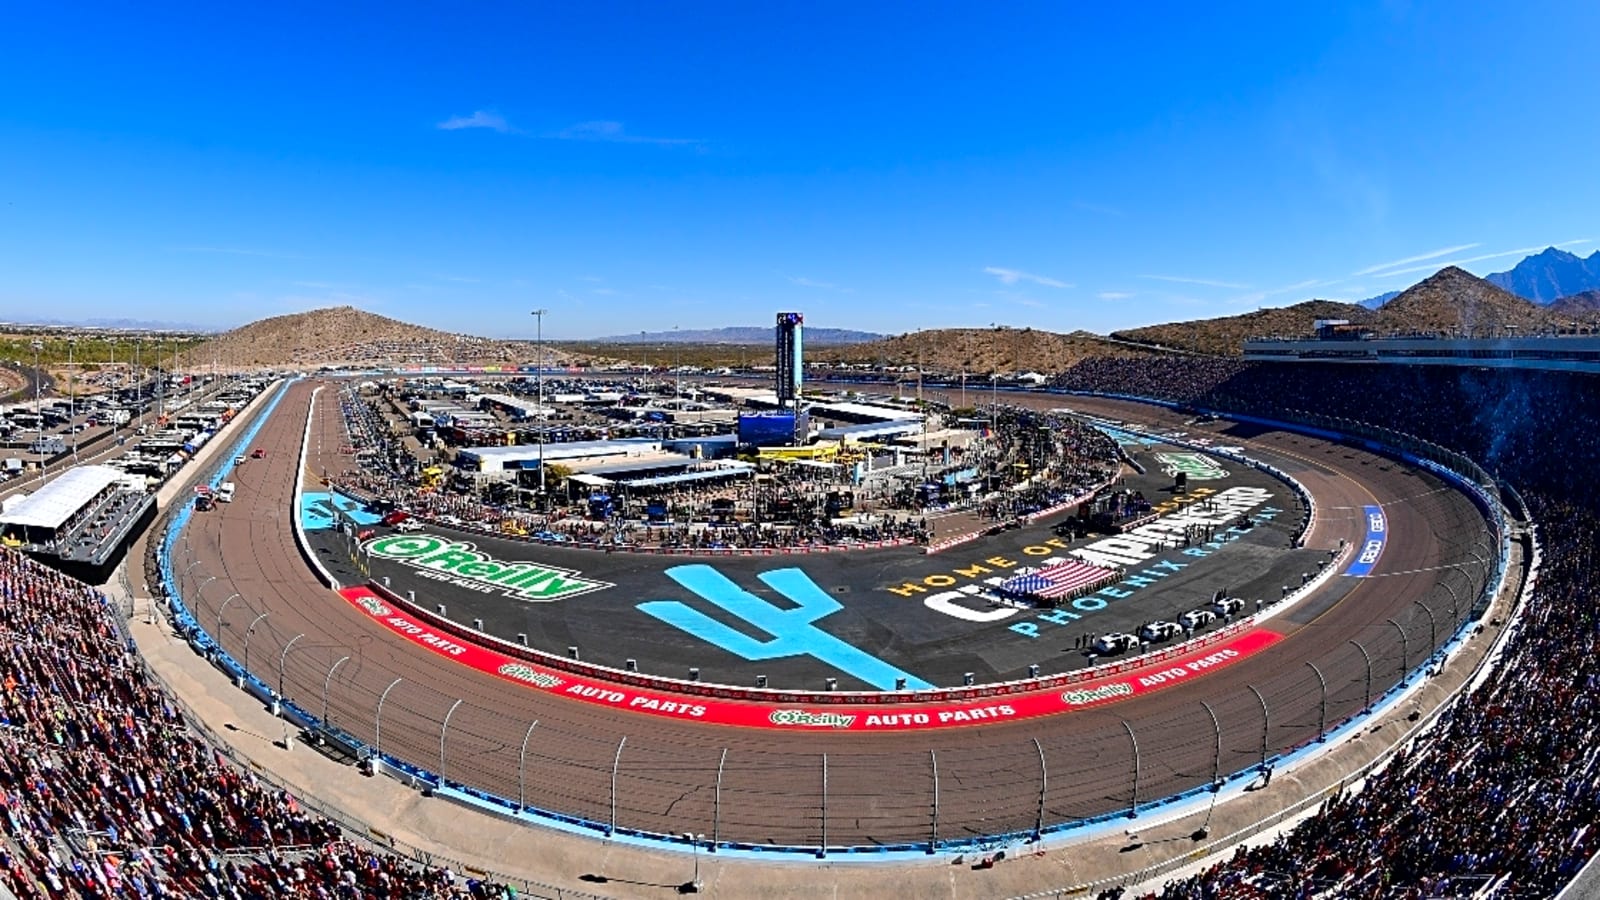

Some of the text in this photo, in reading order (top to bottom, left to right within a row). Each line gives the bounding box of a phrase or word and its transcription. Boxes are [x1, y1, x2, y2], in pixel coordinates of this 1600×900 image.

[360, 533, 612, 601] O'Reilly
[887, 487, 1217, 597] HOME OF ASCAR
[922, 486, 1275, 623] CMPIONSHIP
[1007, 506, 1284, 639] PHOENIX RACEAY
[386, 617, 468, 656] AUTO PARTS
[1138, 667, 1189, 688] AUTO
[1186, 649, 1239, 671] PARTS
[566, 684, 625, 703] AUTO
[629, 695, 707, 717] PARTS
[768, 704, 1017, 728] O'Reilly AUTO PARTS
